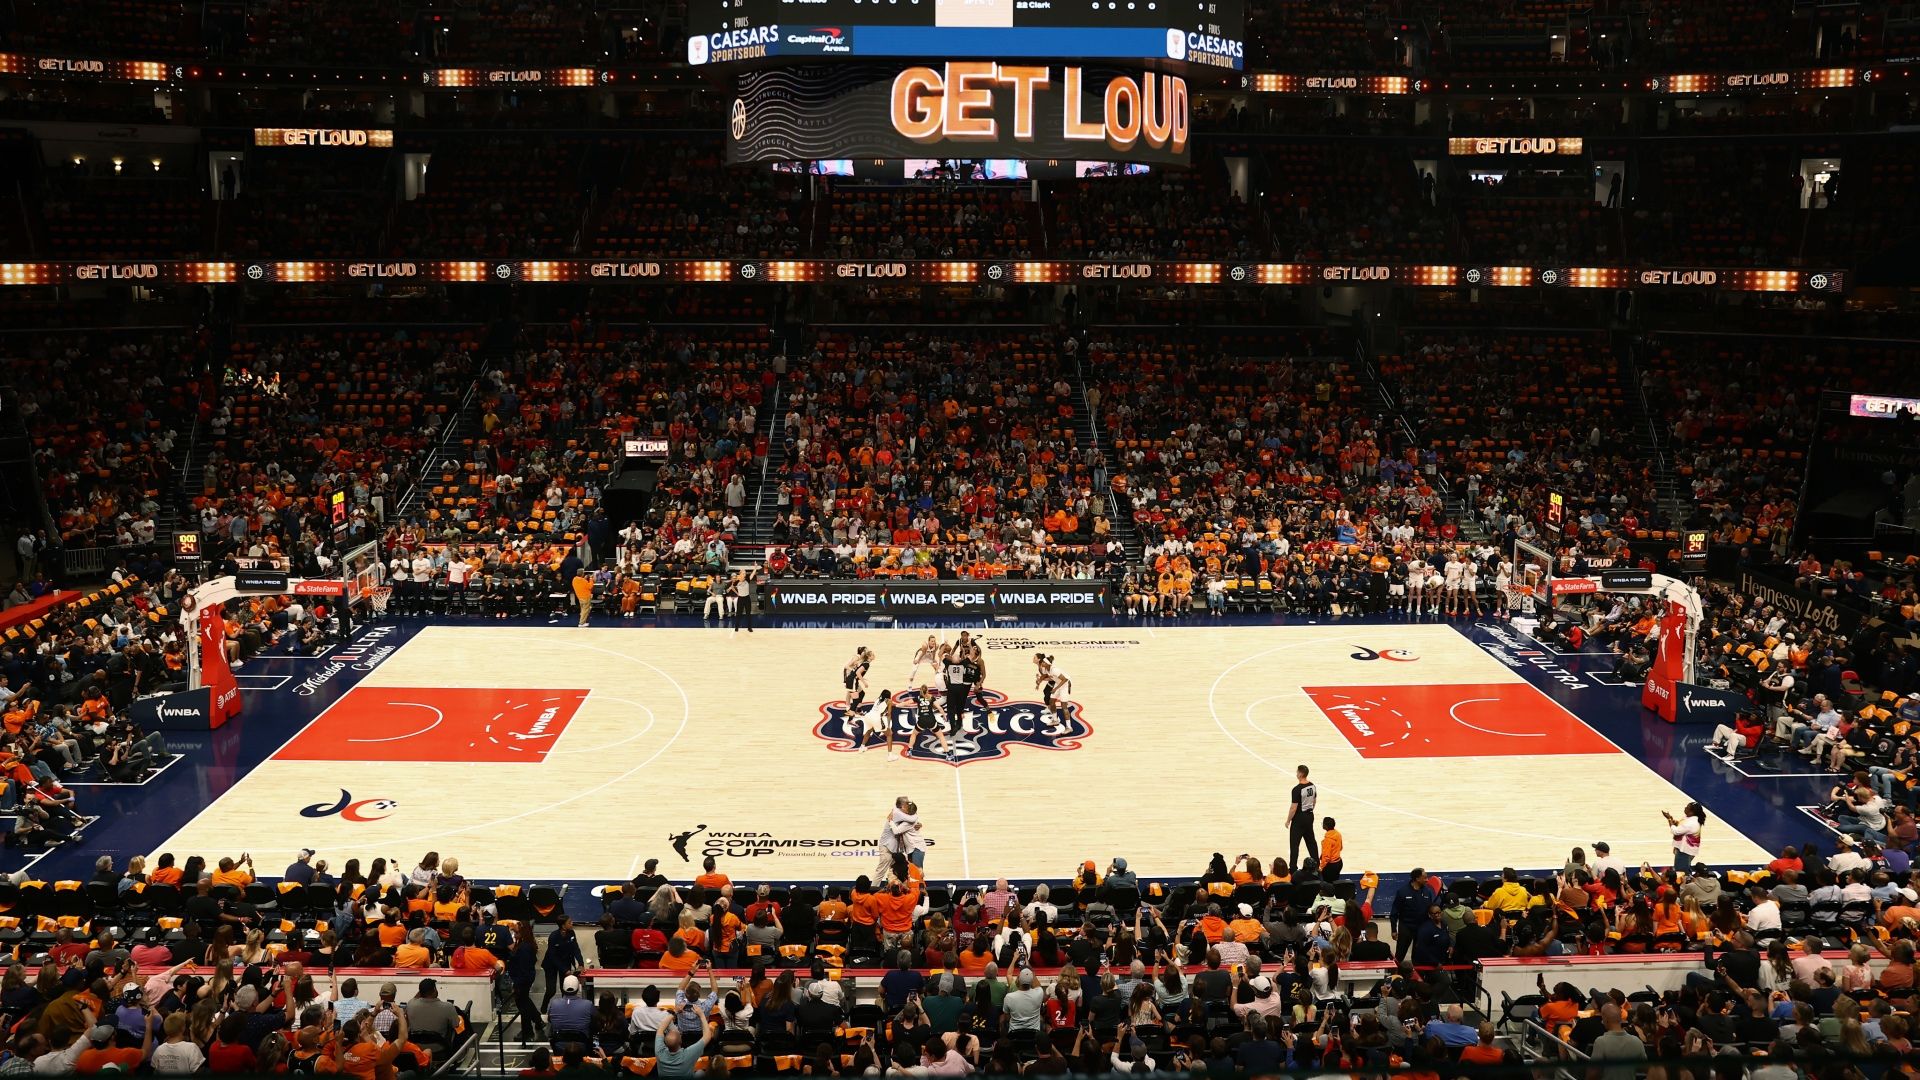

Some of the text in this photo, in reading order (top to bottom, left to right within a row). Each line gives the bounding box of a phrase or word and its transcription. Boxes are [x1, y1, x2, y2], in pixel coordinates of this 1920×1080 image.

[734, 16, 749, 28] FOULS
[711, 24, 779, 49] CAESARS
[1209, 23, 1220, 36] FOULS
[1188, 31, 1244, 58] CAESARS
[711, 45, 767, 63] SPORTSBOOK
[1188, 49, 1234, 70] SPORTSBOOK
[39, 59, 104, 73] GET LOUD
[489, 70, 541, 82] GET LOUD
[1306, 77, 1356, 89] GET LOUD
[1727, 73, 1789, 87] GET LOUD
[890, 61, 1188, 146] GET LOUD
[797, 118, 833, 127] BATTLE
[284, 129, 367, 146] GET LOUD
[754, 138, 791, 150] STRUGGLE
[1475, 137, 1556, 154] GET LOUD
[76, 264, 158, 280] GET LOUD
[348, 263, 417, 278] GET LOUD
[591, 263, 660, 277] GET LOUD
[837, 263, 907, 278] GET LOUD
[1082, 264, 1151, 278] GET LOUD
[1323, 266, 1390, 280] GET LOUD
[1641, 270, 1717, 285] GET LOUD
[1866, 401, 1897, 413] GET
[332, 503, 345, 525] 24
[1548, 502, 1561, 523] 24
[180, 542, 194, 552] 24
[1689, 541, 1701, 551] 24
[1588, 558, 1613, 568] LOUD
[780, 593, 876, 604] WNBA PRIDE
[891, 593, 937, 604] WNBA
[1000, 593, 1094, 604] WNBA PRIDE
[1742, 572, 1840, 632] Hennessy Lofts
[292, 625, 397, 696] Michelob ULTRA
[1528, 656, 1590, 690] ULTRA
[224, 687, 237, 701] AT&T
[1655, 686, 1669, 700] AT&T
[1691, 699, 1726, 707] WNBA
[164, 708, 200, 716] WNBA
[527, 706, 560, 734] WNBA
[1341, 709, 1375, 736] WNBA
[702, 848, 774, 857] CUP
[484, 932, 497, 944] 22
